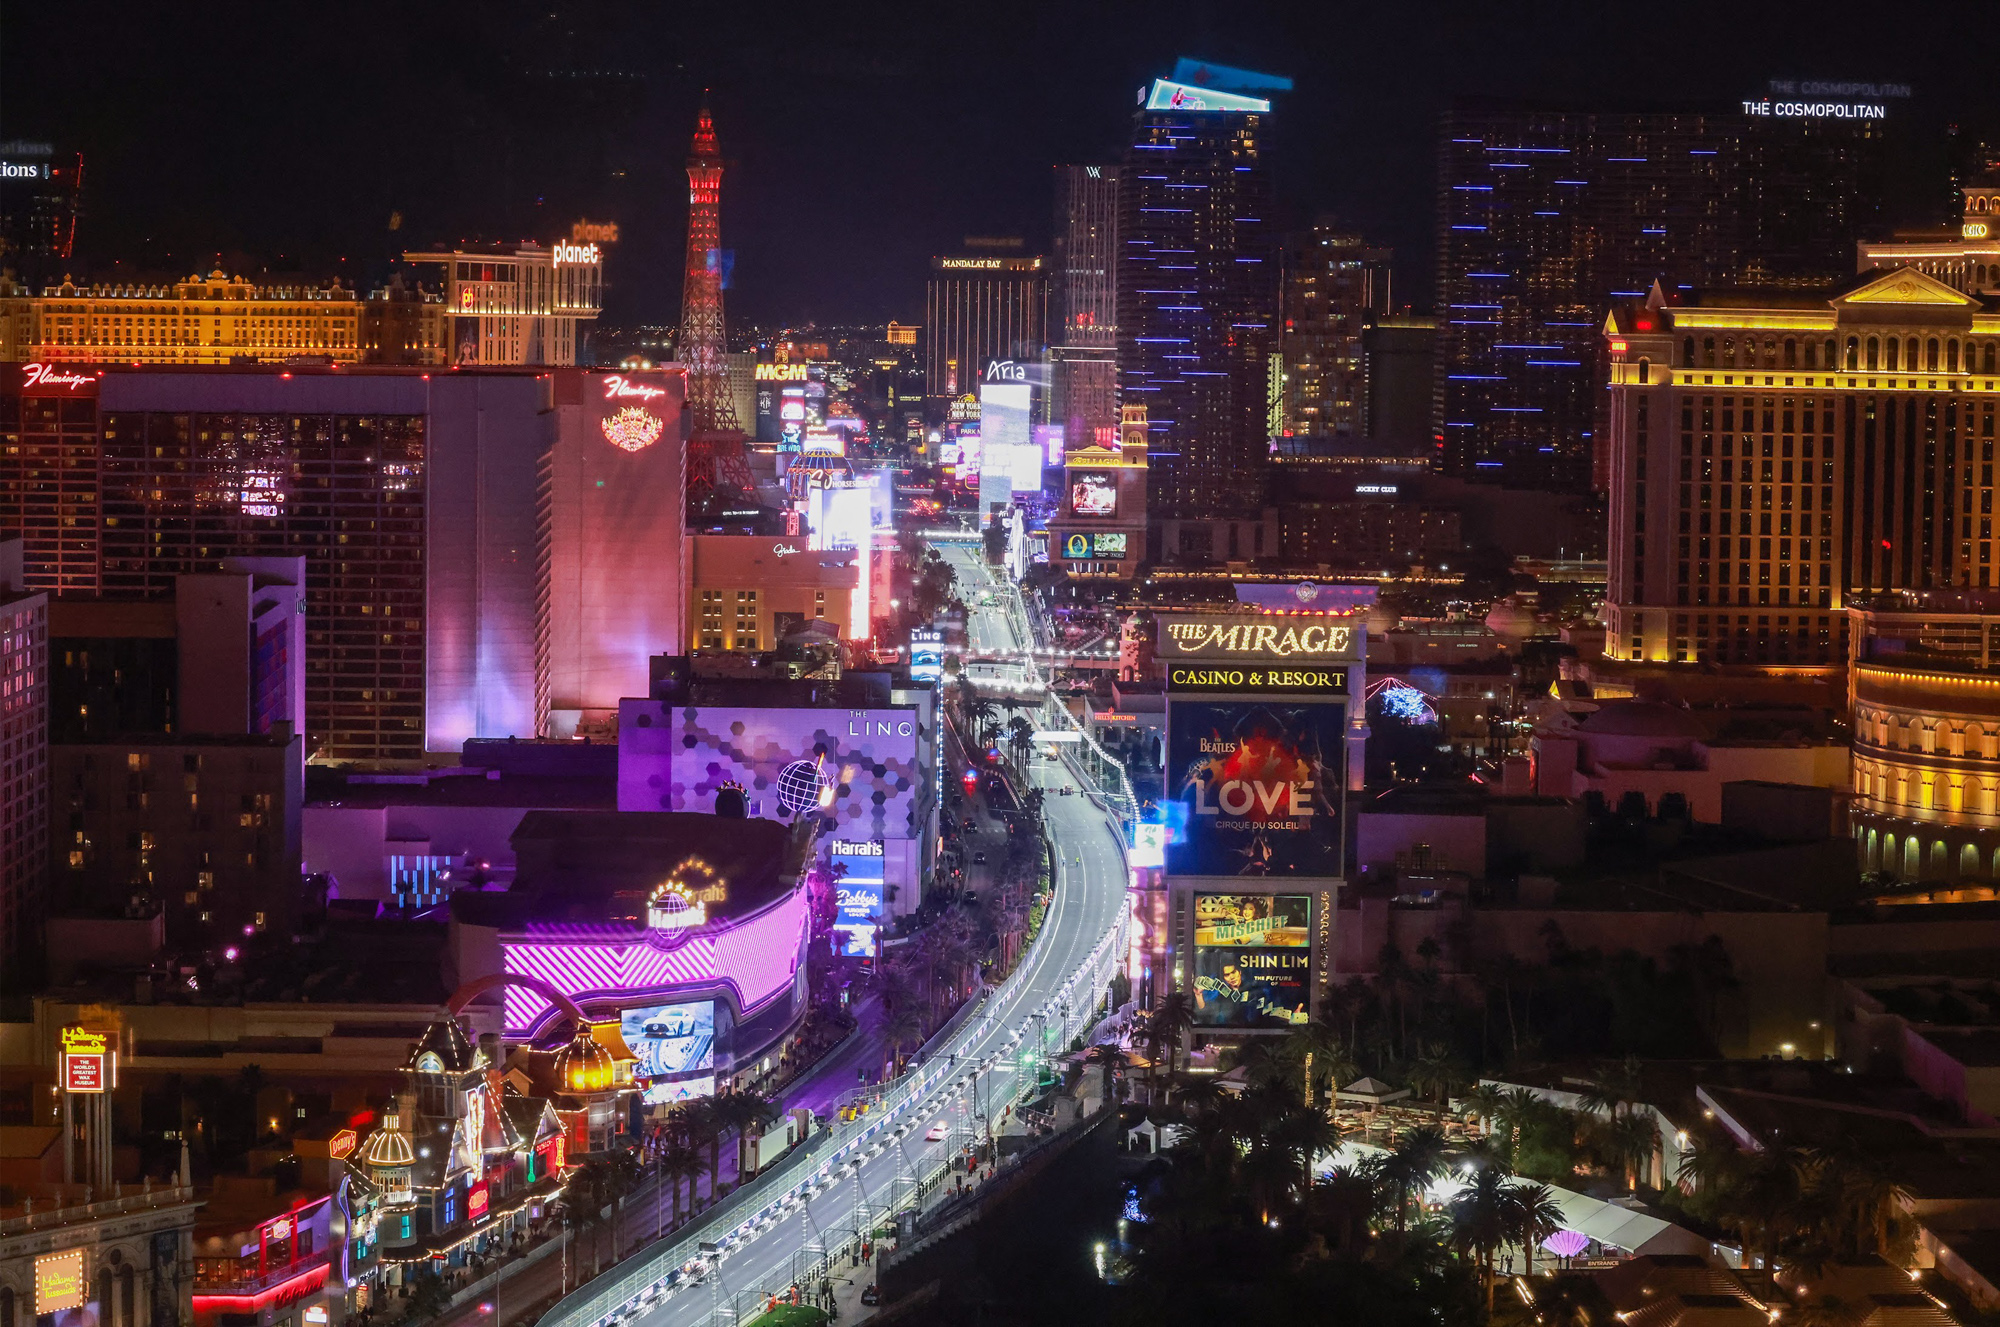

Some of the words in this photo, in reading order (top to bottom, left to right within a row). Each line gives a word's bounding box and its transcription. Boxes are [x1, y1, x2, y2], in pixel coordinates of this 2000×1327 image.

[1743, 101, 1771, 116] THE
[1775, 103, 1886, 119] COSMOPOLITAN
[0, 161, 38, 177] ions
[553, 239, 599, 268] planet
[942, 259, 984, 269] MANDALAY
[986, 260, 1002, 269] BAY
[22, 363, 96, 391] Flamingo
[755, 363, 808, 381] MGM
[986, 360, 1026, 382] Aria
[603, 375, 666, 401] Flamingo
[951, 402, 965, 410] NEW
[911, 632, 941, 640] LINQ
[1168, 624, 1207, 640] THE
[1178, 625, 1351, 656] MIRAGE
[1172, 670, 1244, 685] CASINO
[1249, 672, 1263, 685] &
[1267, 671, 1345, 687] RESORT
[849, 710, 867, 718] THE
[849, 721, 913, 737] LINQ
[1195, 779, 1315, 816] LOVE
[1216, 820, 1250, 832] CIRQUE
[1252, 820, 1265, 830] DU
[1267, 821, 1299, 830] SOLEIL
[835, 889, 880, 907] Bobby's
[1216, 915, 1289, 939] MISCHIEF
[1240, 955, 1277, 968] SHIN
[1281, 955, 1308, 968] LIM
[331, 1132, 356, 1155] Denny's
[42, 1272, 77, 1288] Madame
[42, 1283, 77, 1299] Tussauds
